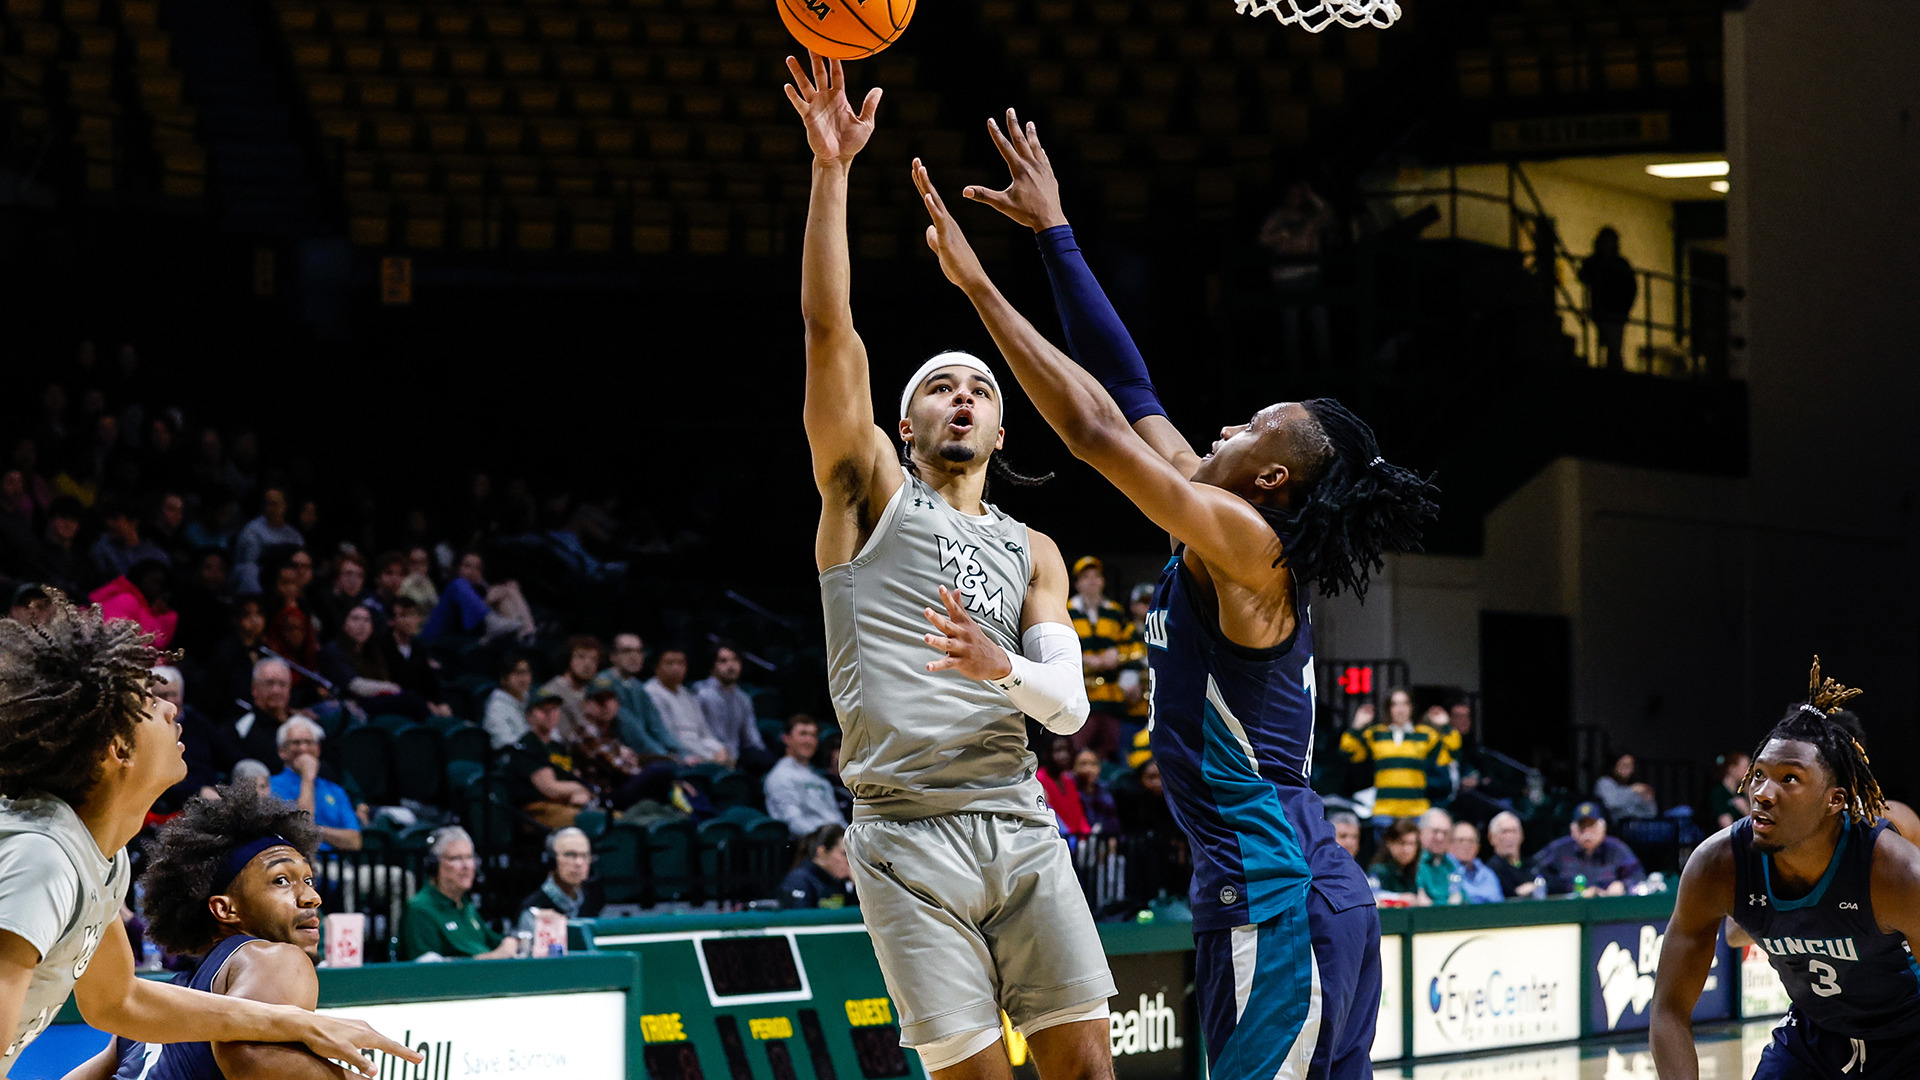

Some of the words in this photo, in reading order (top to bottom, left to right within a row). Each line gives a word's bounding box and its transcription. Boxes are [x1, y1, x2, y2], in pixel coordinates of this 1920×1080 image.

[1838, 901, 1859, 911] CAA
[1762, 936, 1859, 962] UNCW
[1808, 958, 1842, 998] 3
[845, 997, 893, 1027] GUEST
[1446, 969, 1558, 1037] EyeCenter
[640, 1012, 688, 1043] TRIBE
[748, 1016, 794, 1040] PERIOD
[1109, 991, 1184, 1057] ealth.
[463, 1051, 503, 1075] Save
[508, 1049, 567, 1071] Borrow
